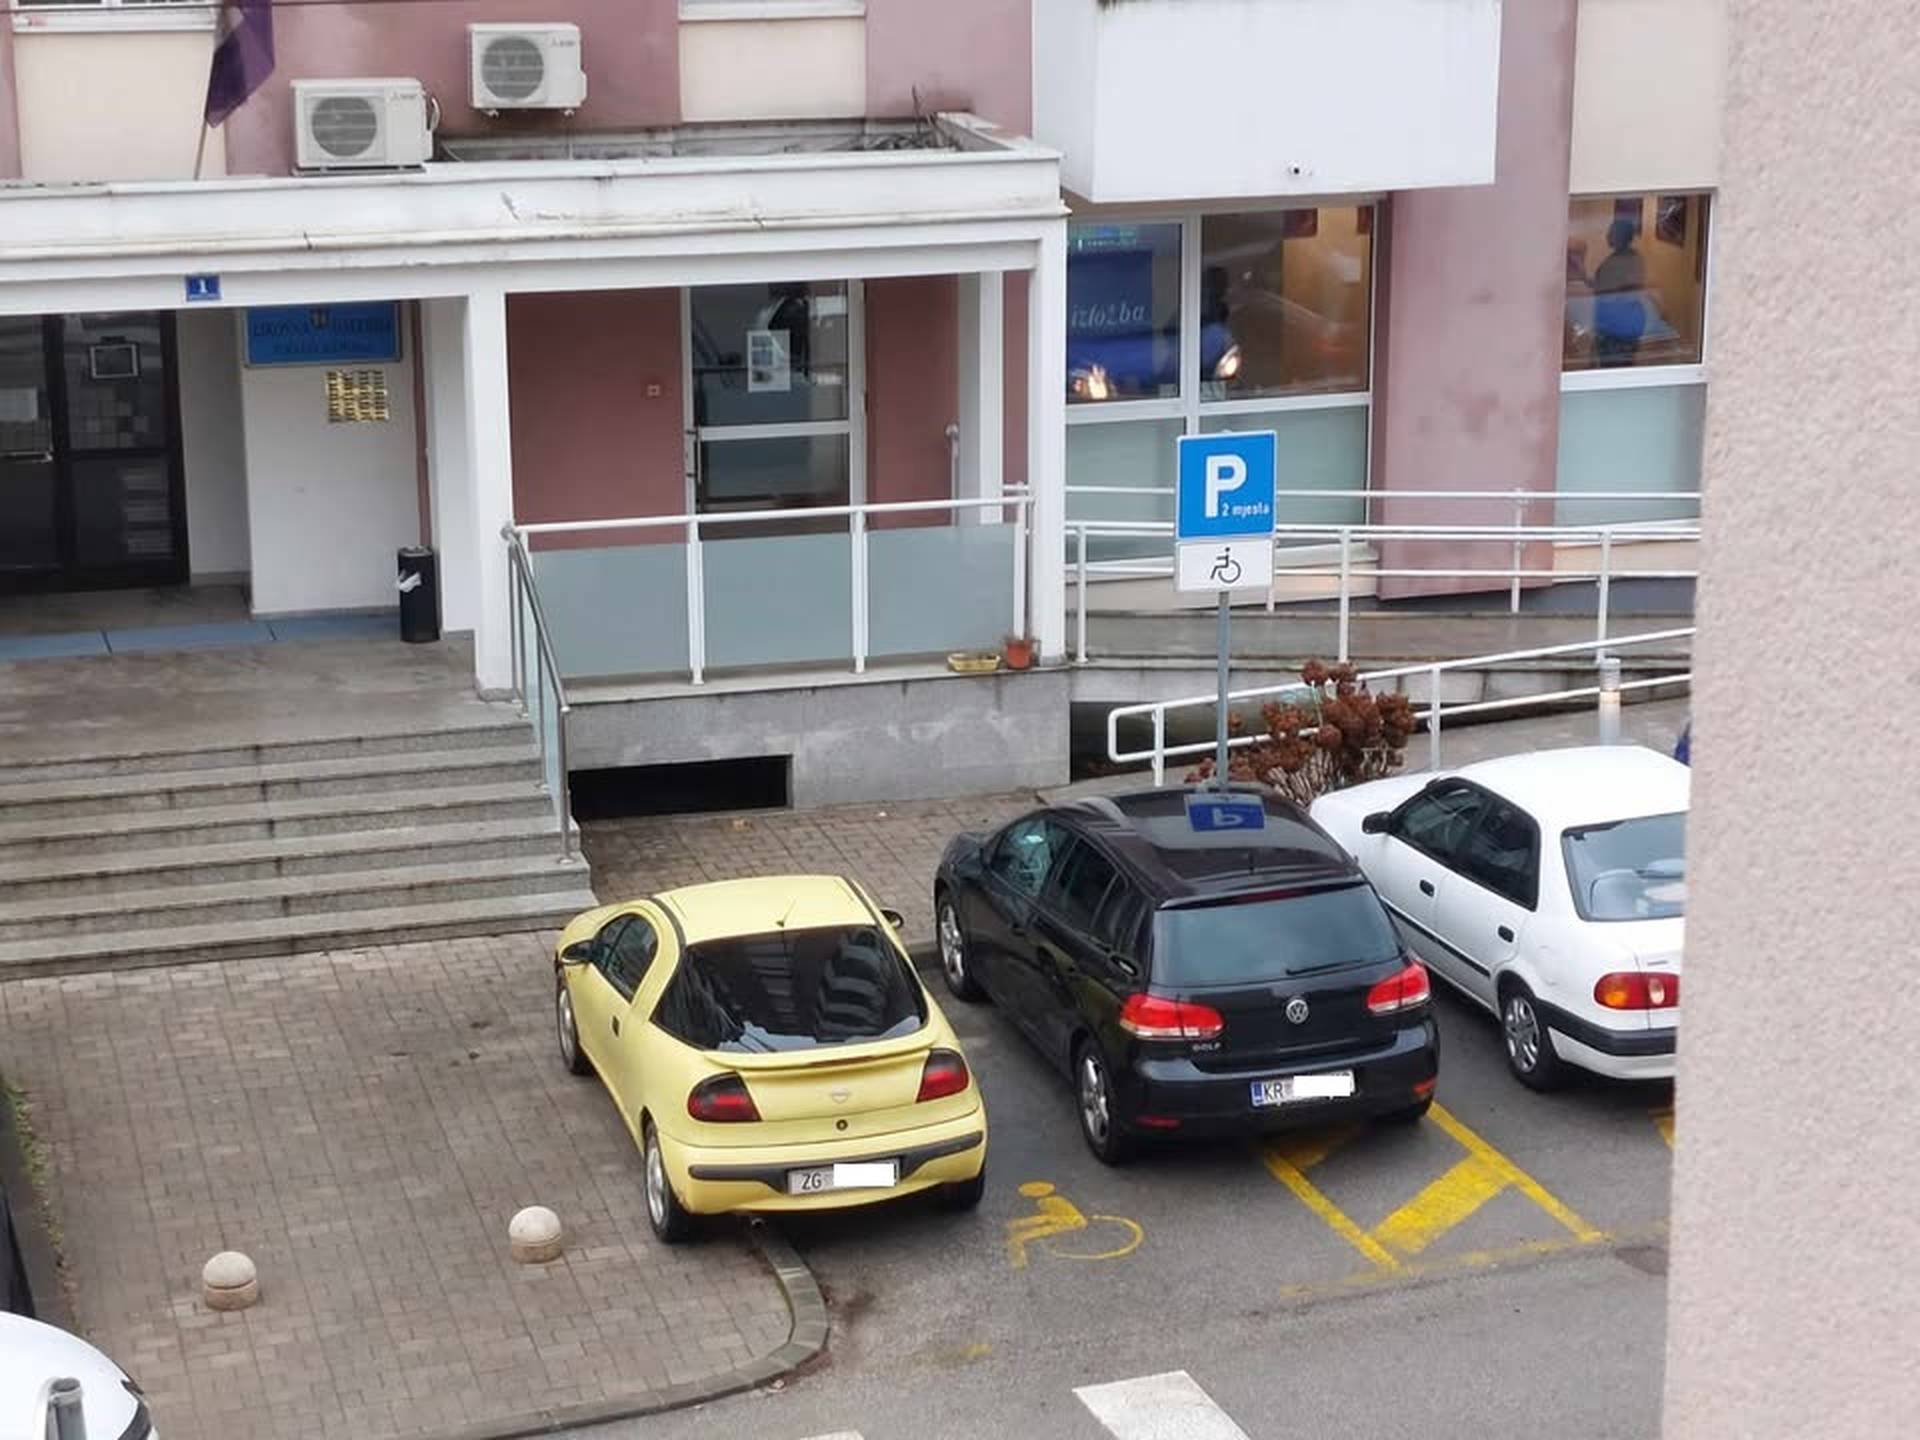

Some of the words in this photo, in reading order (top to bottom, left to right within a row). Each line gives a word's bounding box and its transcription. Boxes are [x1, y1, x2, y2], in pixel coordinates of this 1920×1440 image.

[1205, 453, 1247, 518] P
[1221, 502, 1229, 516] 2
[1232, 501, 1270, 518] mjesta
[1263, 1082, 1285, 1101] KR
[802, 1172, 823, 1191] ZG
